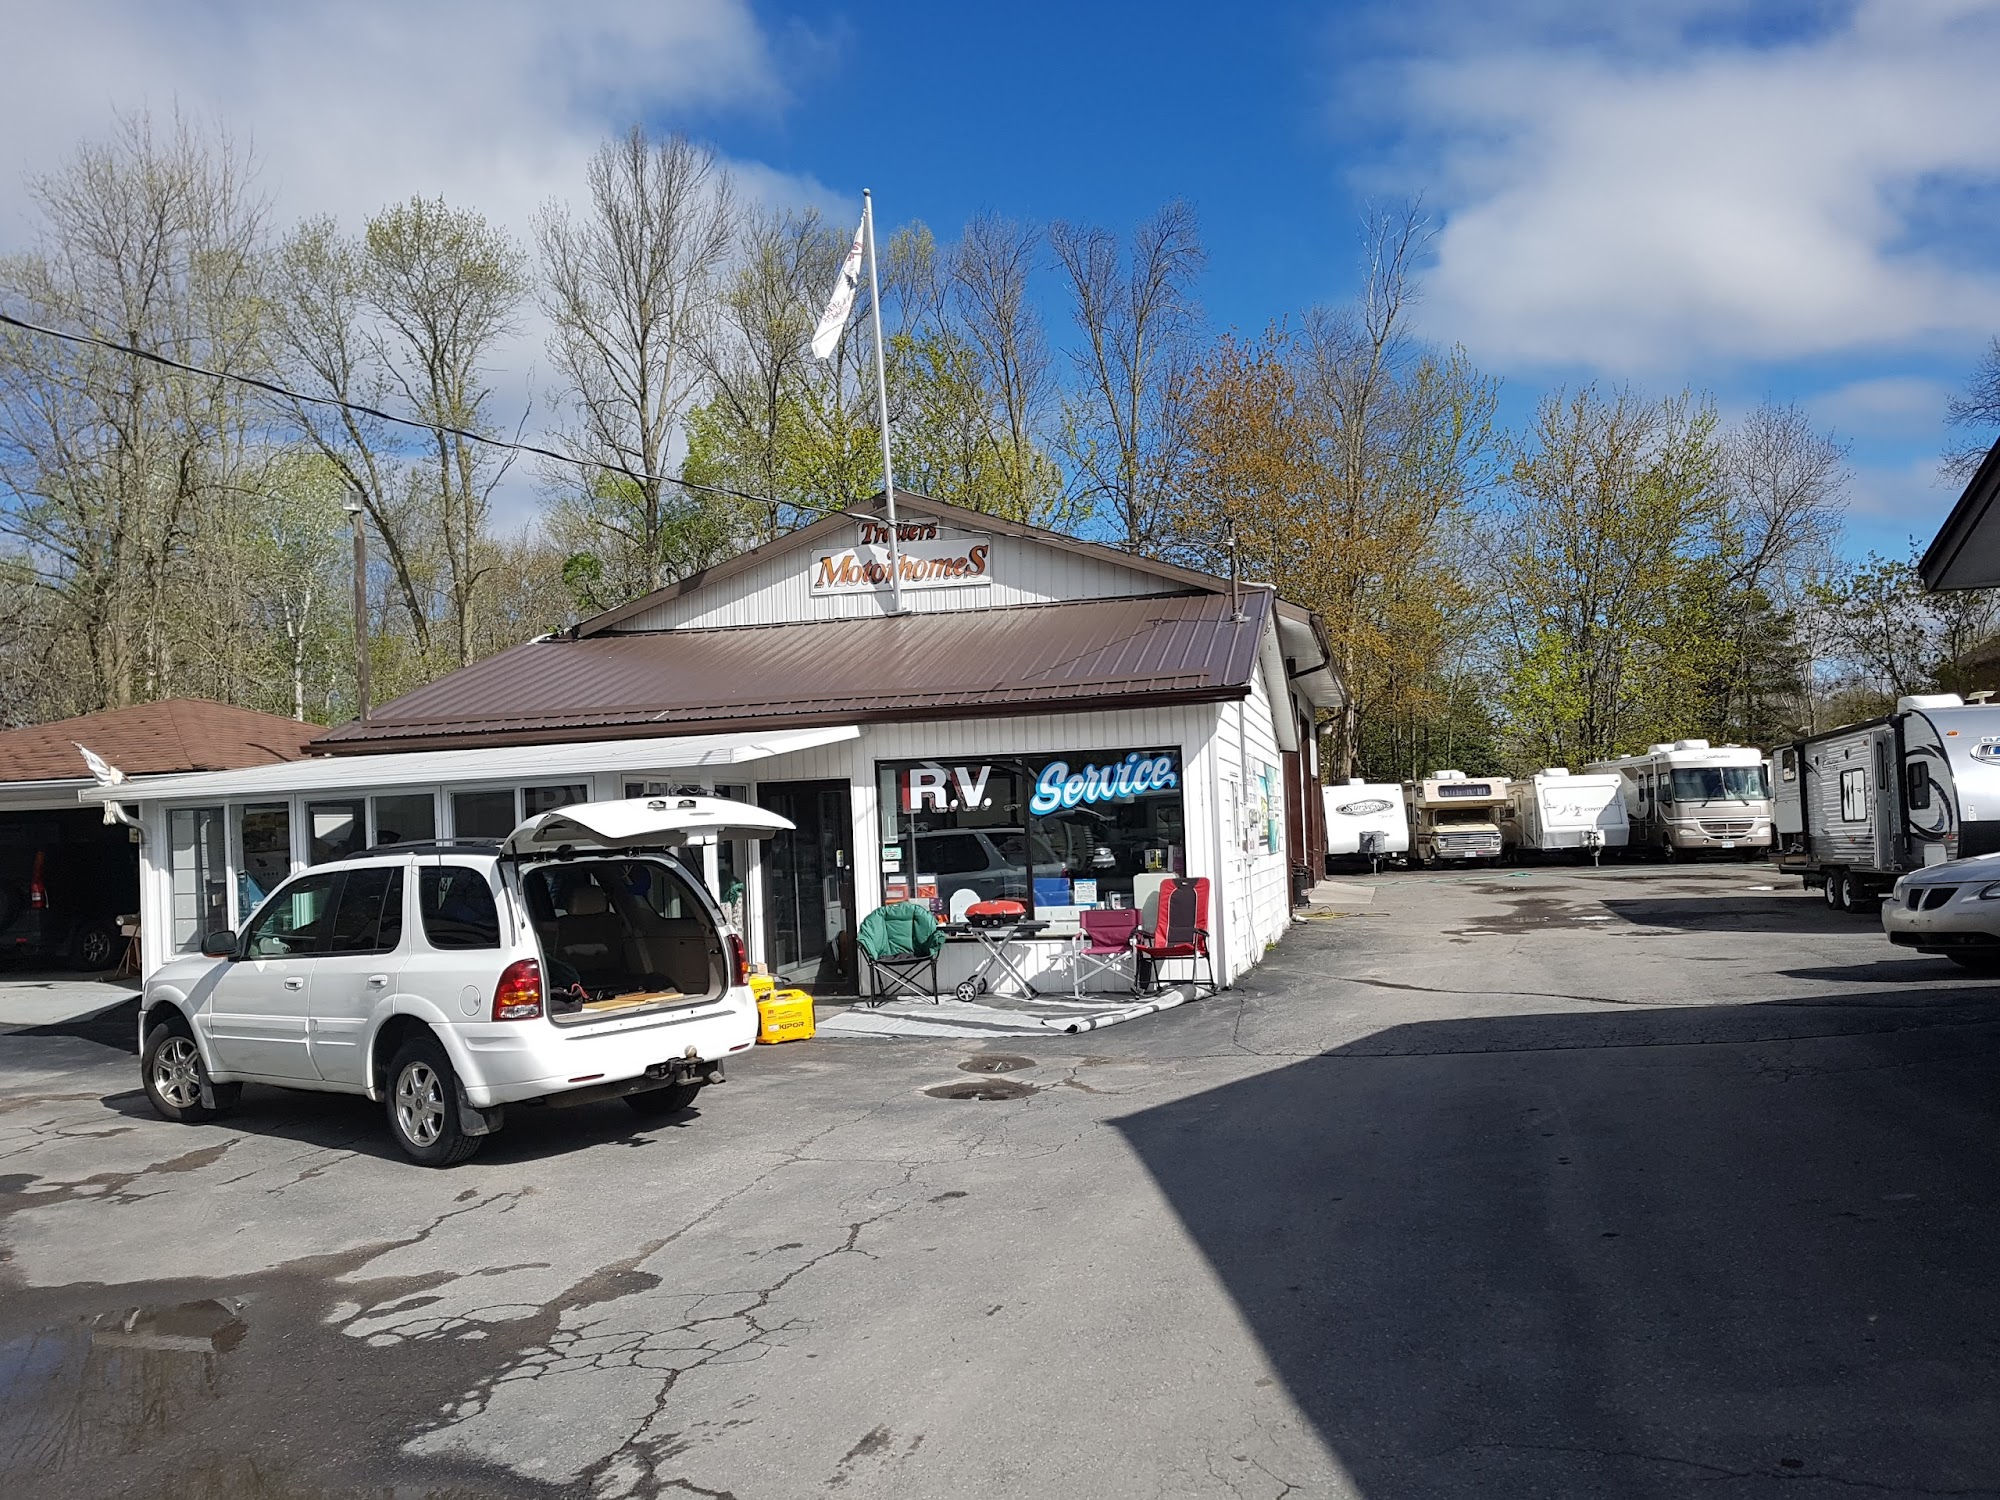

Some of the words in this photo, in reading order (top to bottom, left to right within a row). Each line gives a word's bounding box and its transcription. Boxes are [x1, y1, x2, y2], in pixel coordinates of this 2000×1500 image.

[905, 766, 992, 812] R.V.
[1030, 752, 1177, 815] Service
[779, 1021, 805, 1030] KIPOR
